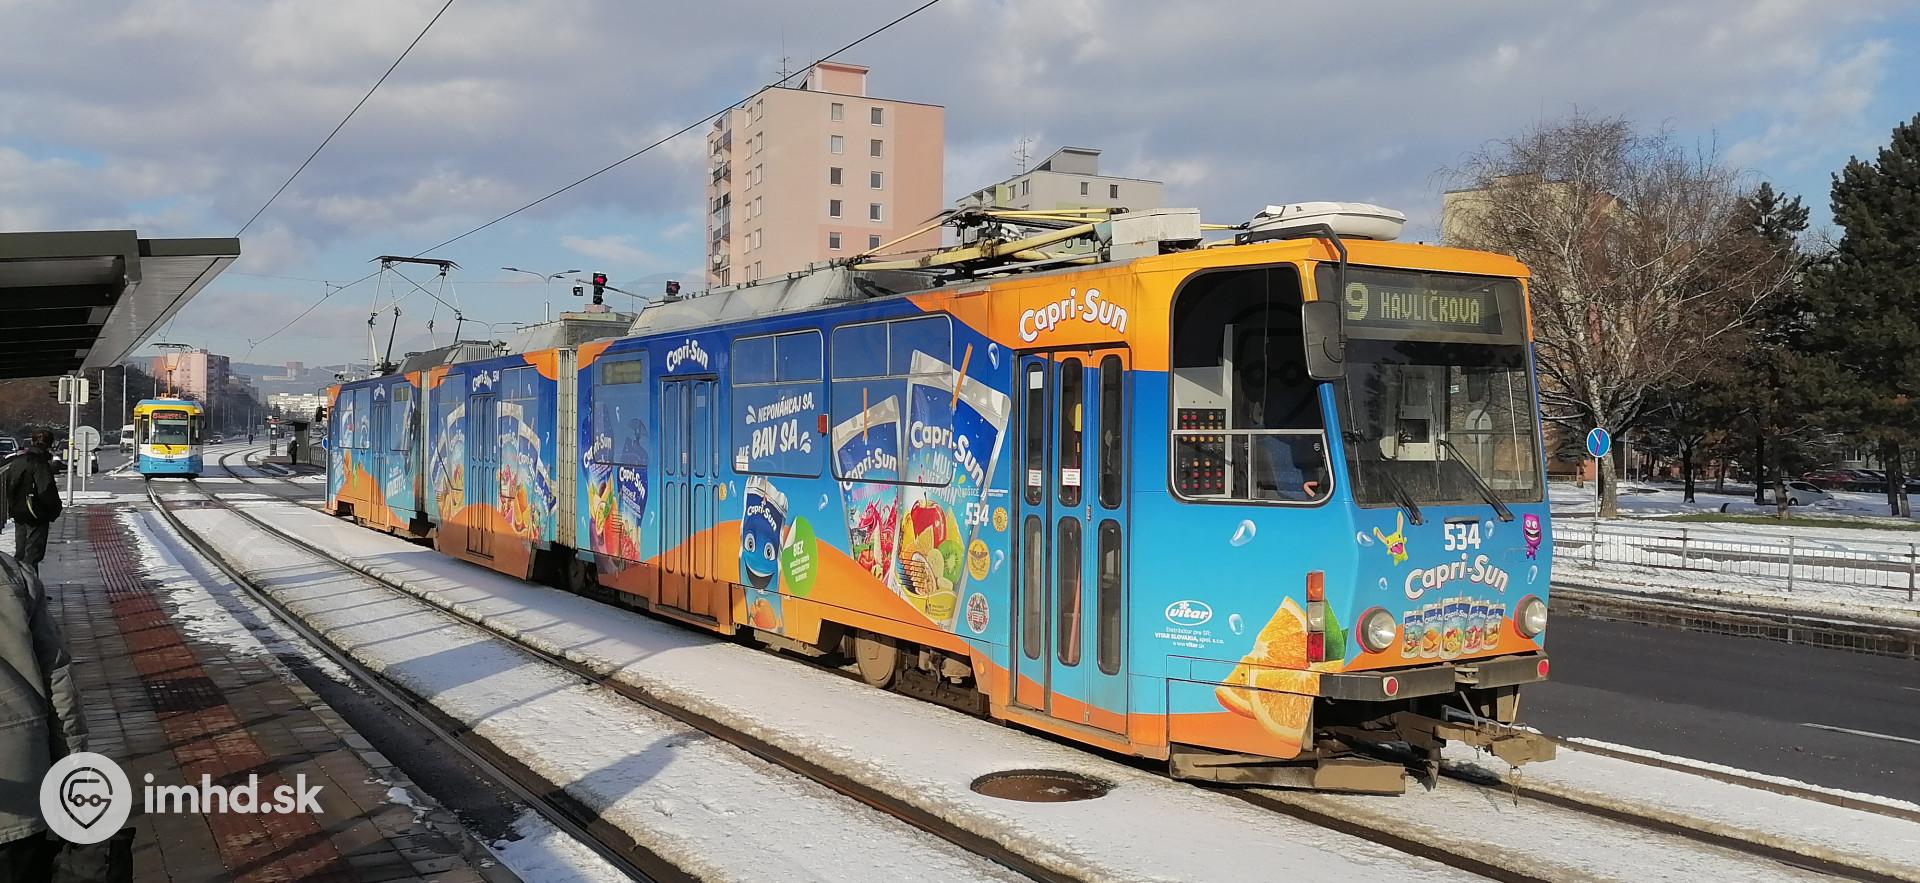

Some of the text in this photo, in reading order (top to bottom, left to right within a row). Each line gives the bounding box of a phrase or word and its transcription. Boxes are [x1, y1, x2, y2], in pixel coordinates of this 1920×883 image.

[1019, 288, 1127, 343] Capri-Sun
[1345, 282, 1480, 324] 9 HAVLÍČKOVA
[666, 339, 709, 373] Capri-Sun
[751, 425, 778, 460] BAV
[779, 419, 798, 452] SA
[910, 420, 984, 487] Capri-Sun
[619, 466, 646, 499] Capri-Sun
[843, 447, 897, 491] Capri-Sun
[747, 502, 777, 532] Capri-Sun
[965, 503, 989, 526] 534
[1444, 523, 1481, 551] 534
[1404, 552, 1508, 599] Capri-Sun
[1169, 604, 1209, 620] vitar
